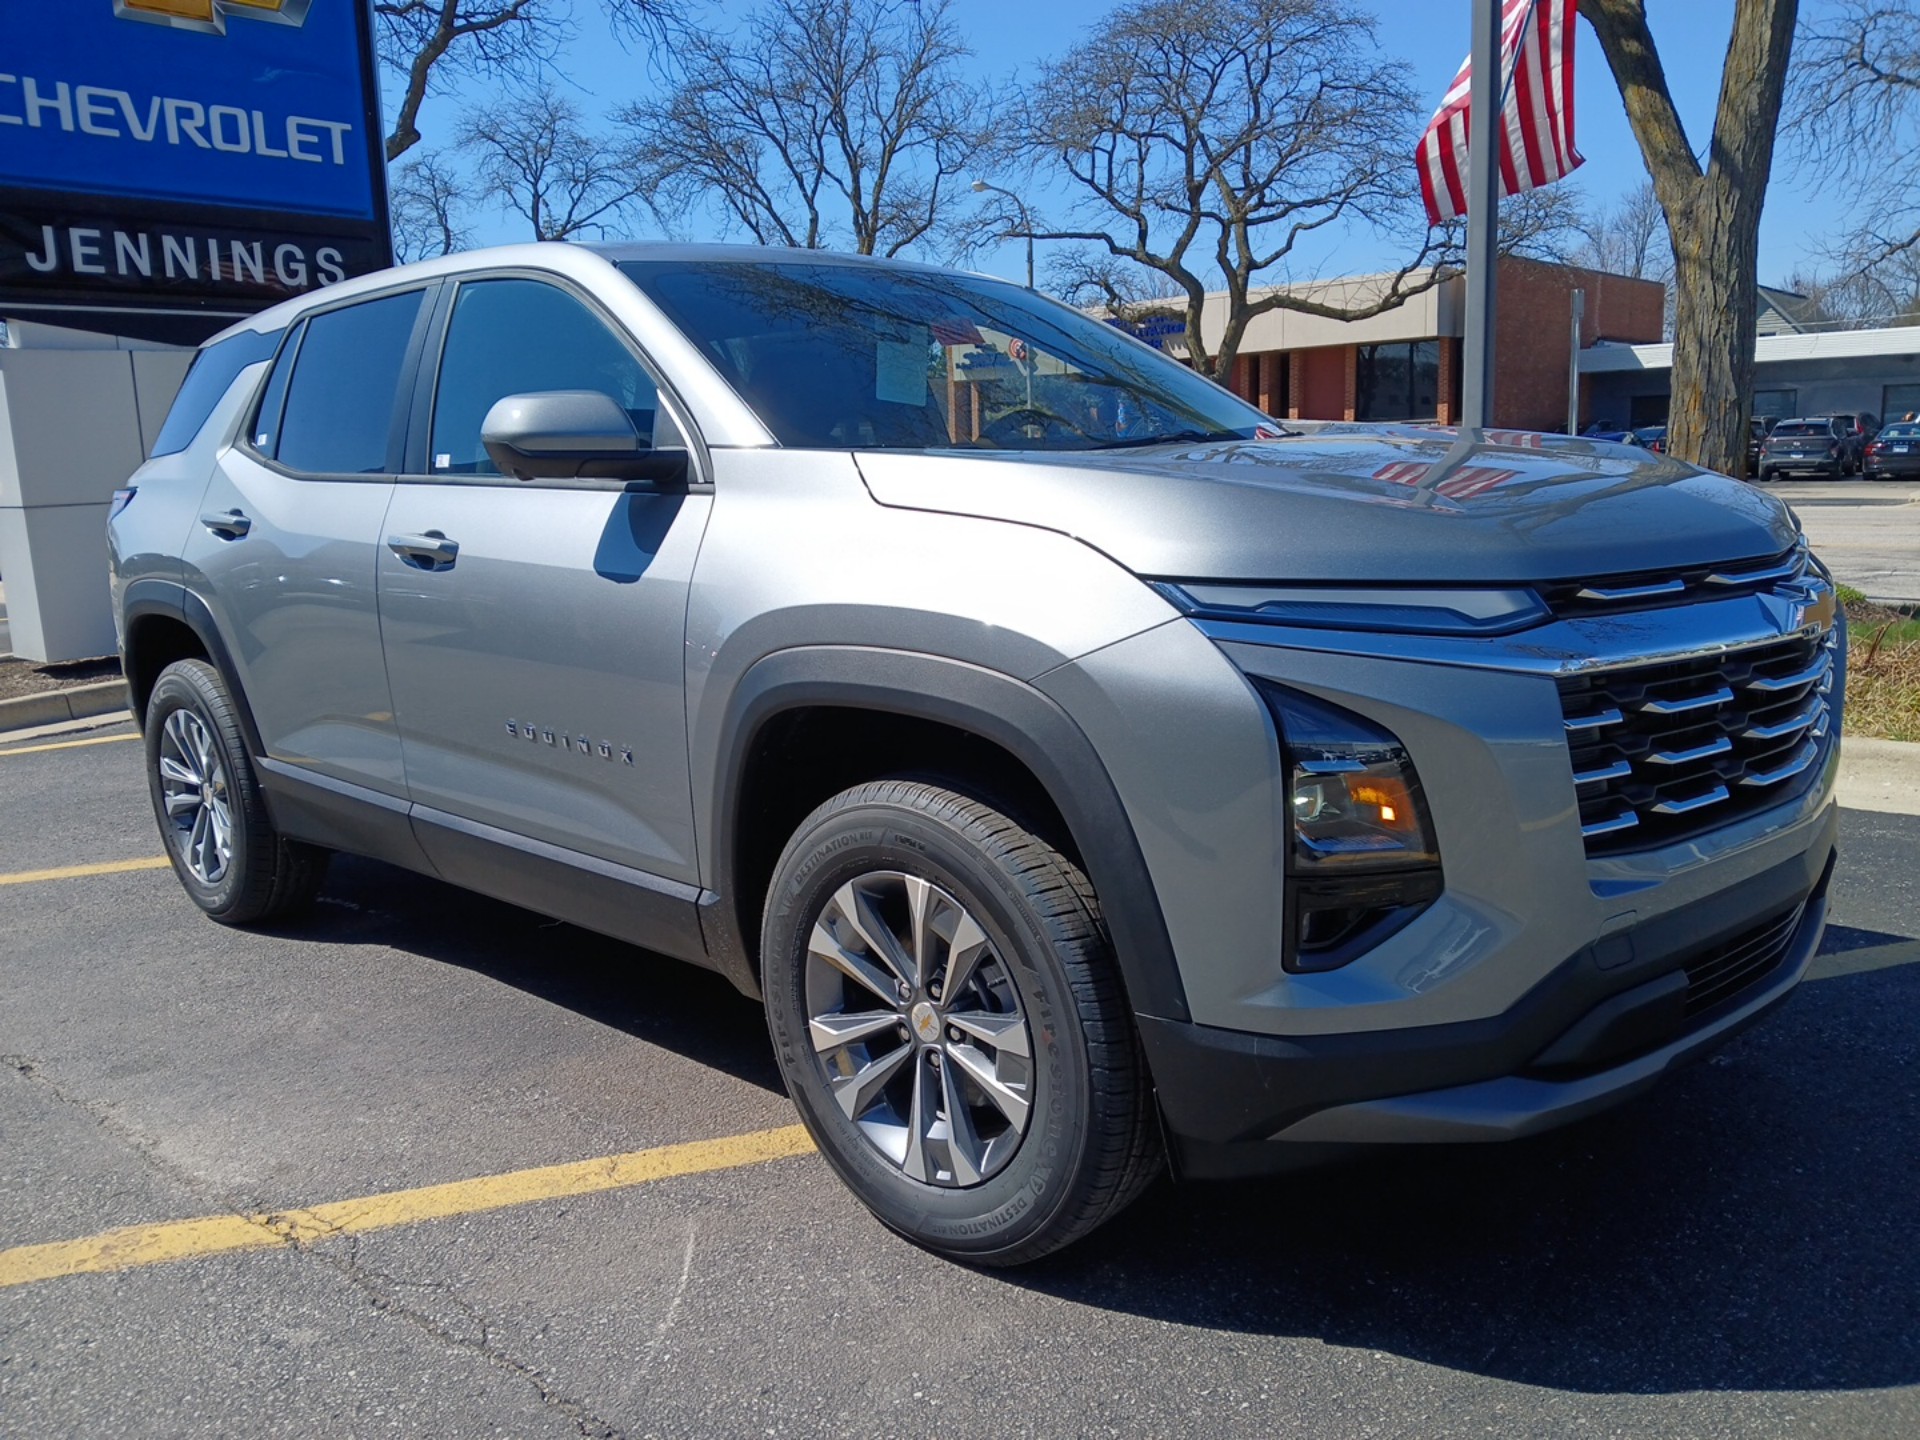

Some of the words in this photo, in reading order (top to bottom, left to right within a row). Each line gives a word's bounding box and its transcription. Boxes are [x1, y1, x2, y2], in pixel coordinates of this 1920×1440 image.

[25, 225, 346, 287] JENNINGS
[505, 718, 634, 764] EQUINOX
[794, 833, 858, 885] DESTINATION
[949, 1197, 1028, 1235] DESTINATION
